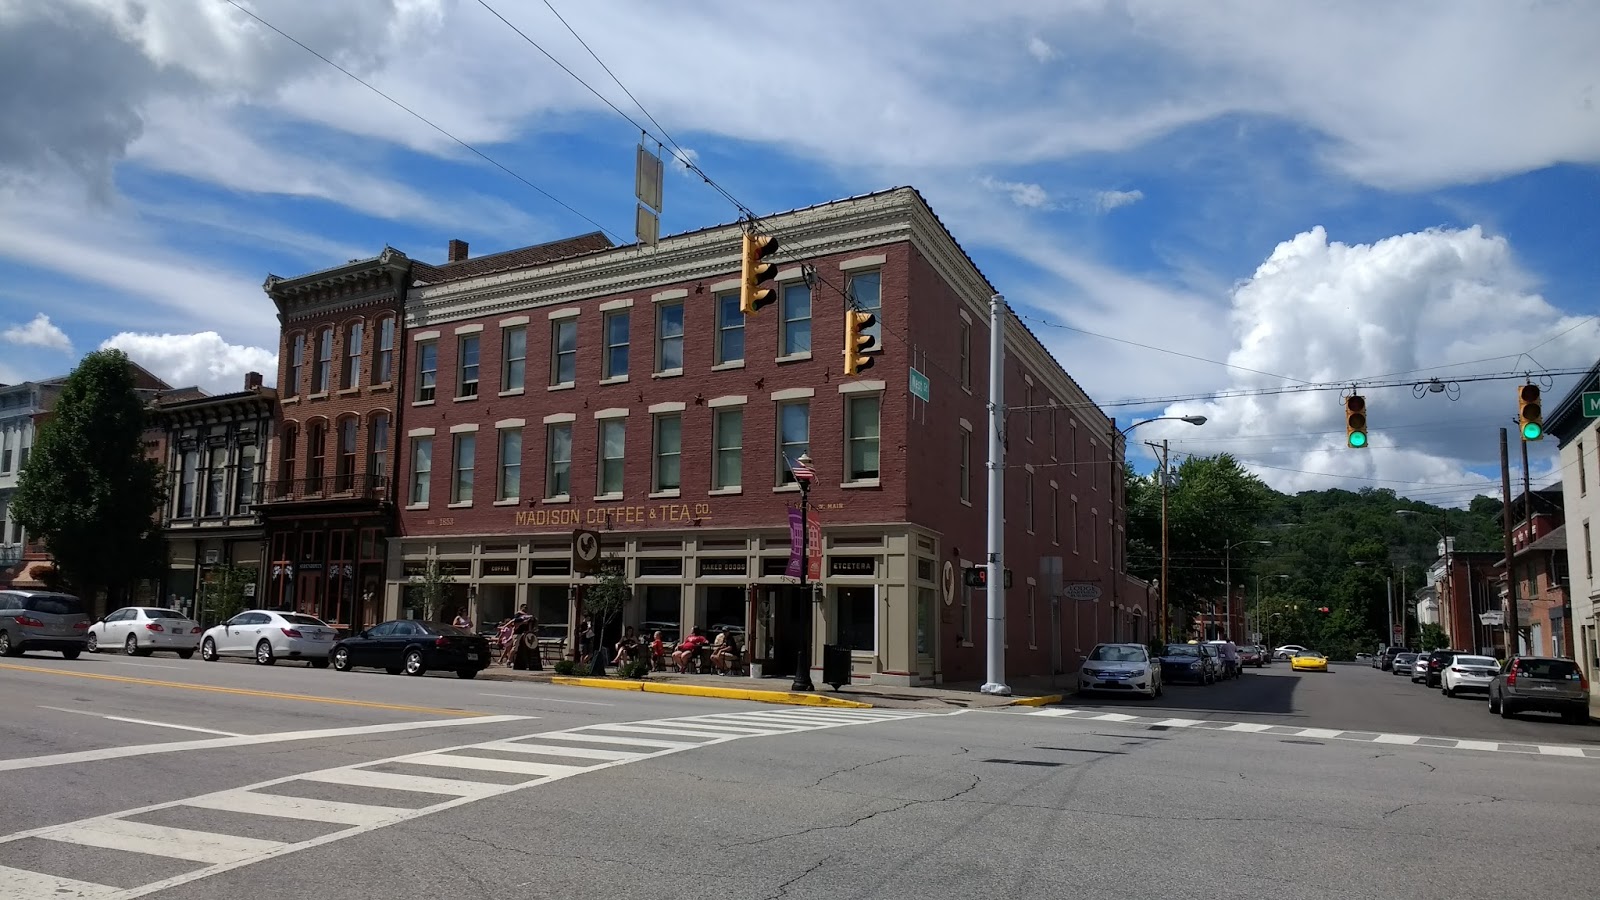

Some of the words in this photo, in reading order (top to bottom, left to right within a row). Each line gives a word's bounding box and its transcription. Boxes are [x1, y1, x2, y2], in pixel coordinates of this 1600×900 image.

[515, 509, 580, 526] MADISON
[586, 506, 645, 524] COFFEE
[649, 508, 657, 519] &
[659, 504, 691, 521] TEA
[695, 503, 712, 515] CO.
[833, 562, 871, 570] ETCETERA
[979, 571, 986, 582] 9
